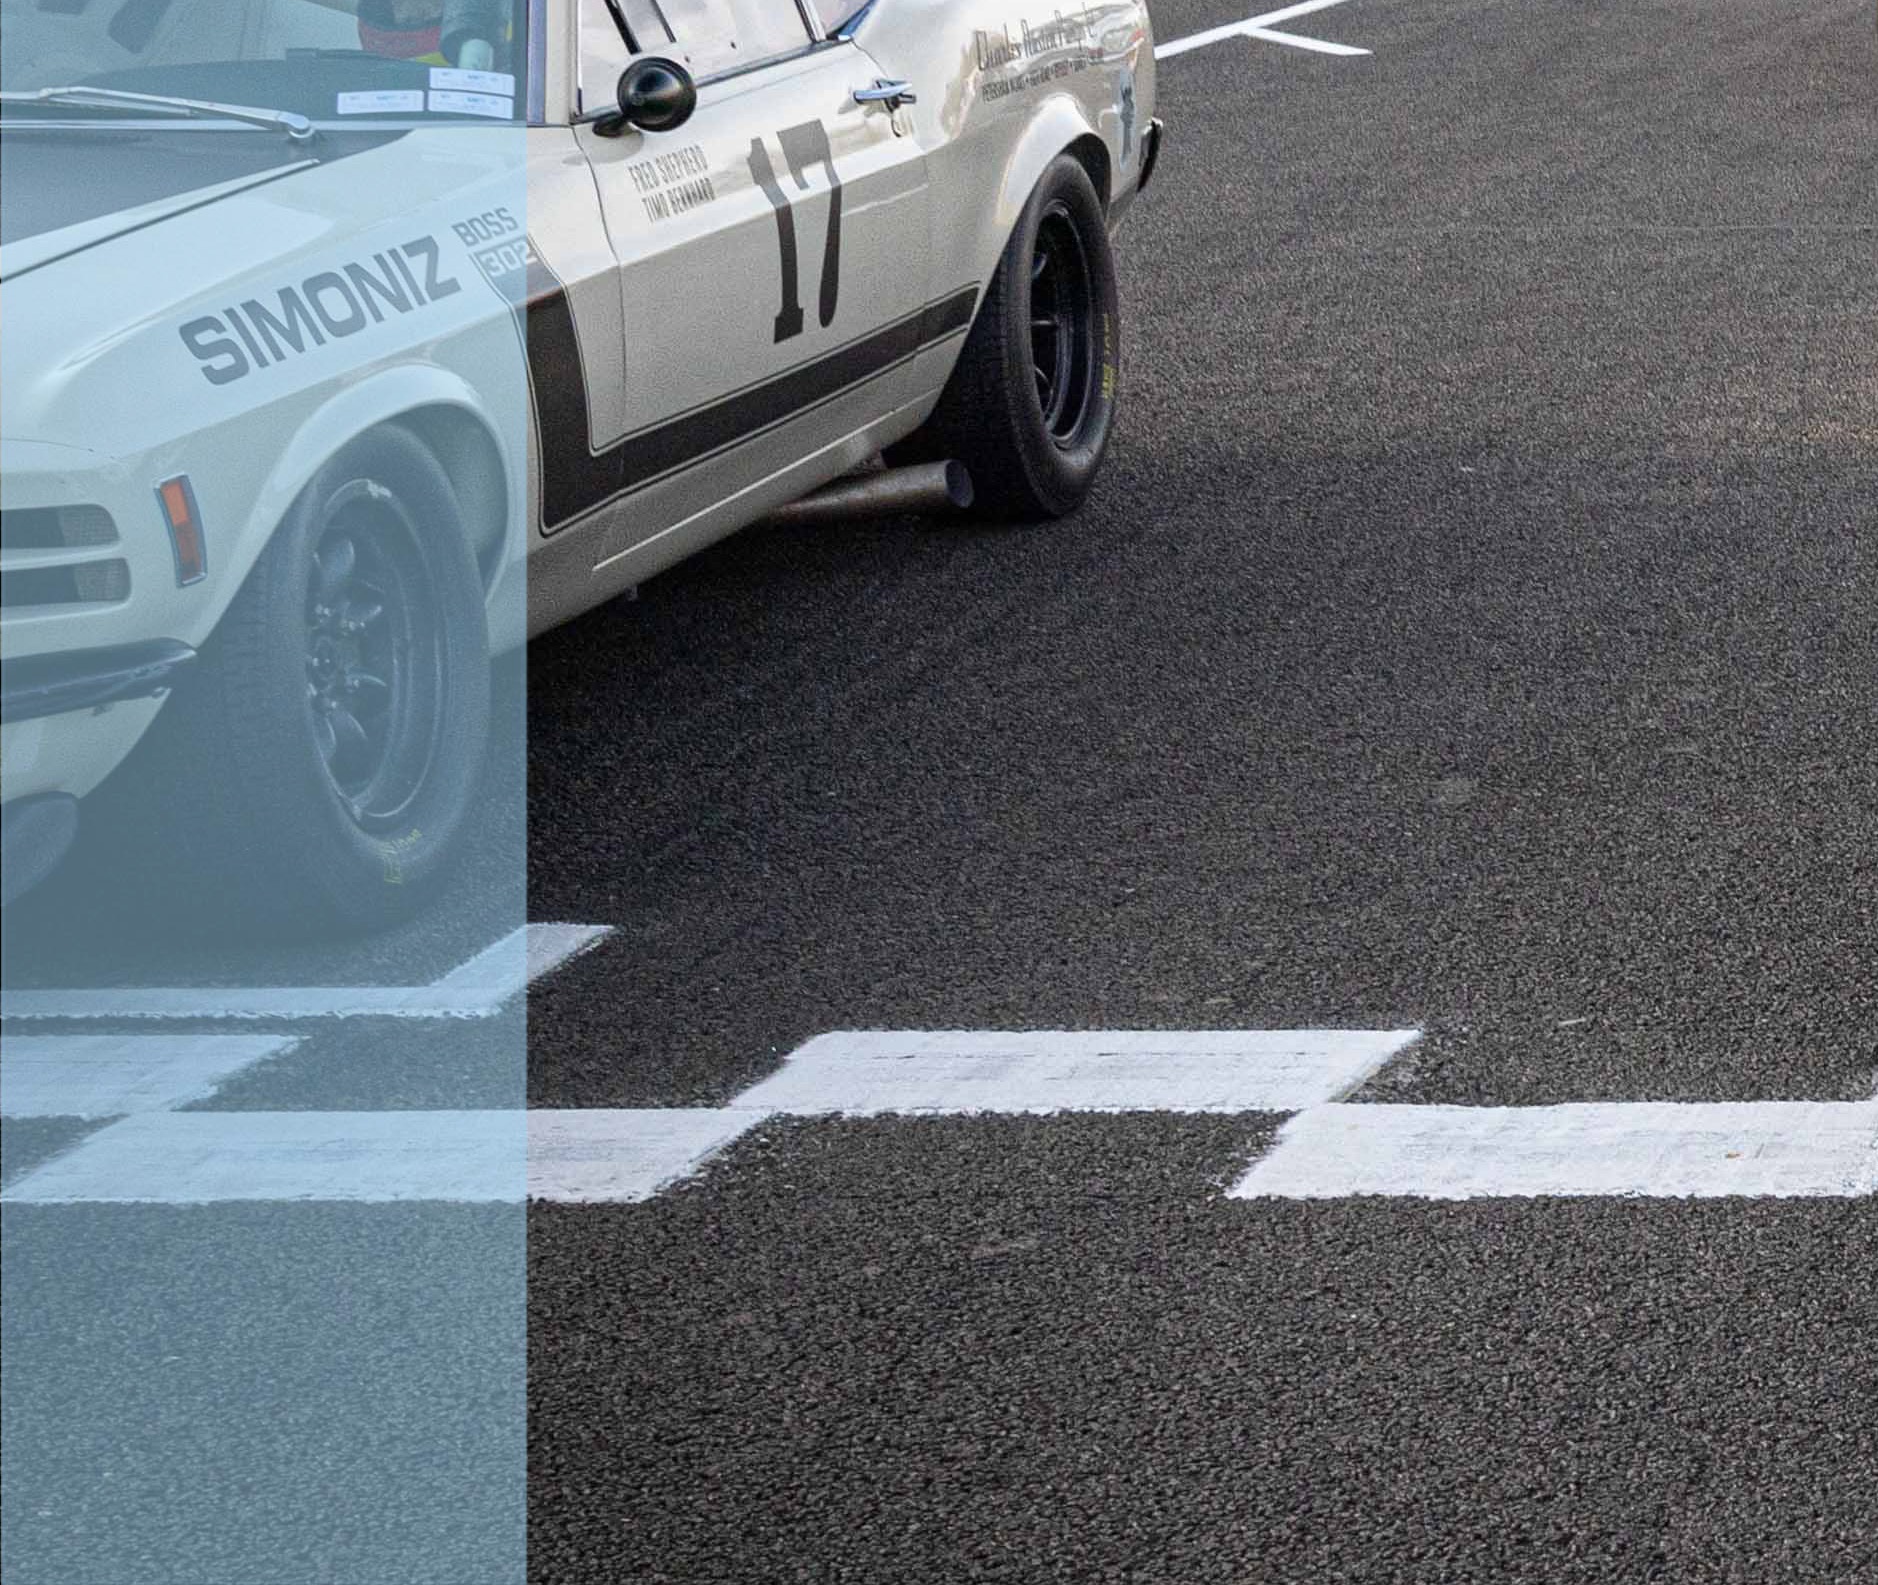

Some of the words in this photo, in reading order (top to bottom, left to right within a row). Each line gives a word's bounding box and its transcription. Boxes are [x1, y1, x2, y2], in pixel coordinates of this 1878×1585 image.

[627, 161, 660, 195] FRED
[451, 206, 519, 248] BOSS
[641, 192, 671, 225] TIMO
[746, 118, 844, 345] 17
[482, 239, 540, 278] 302
[179, 234, 462, 387] SIMONIZ
